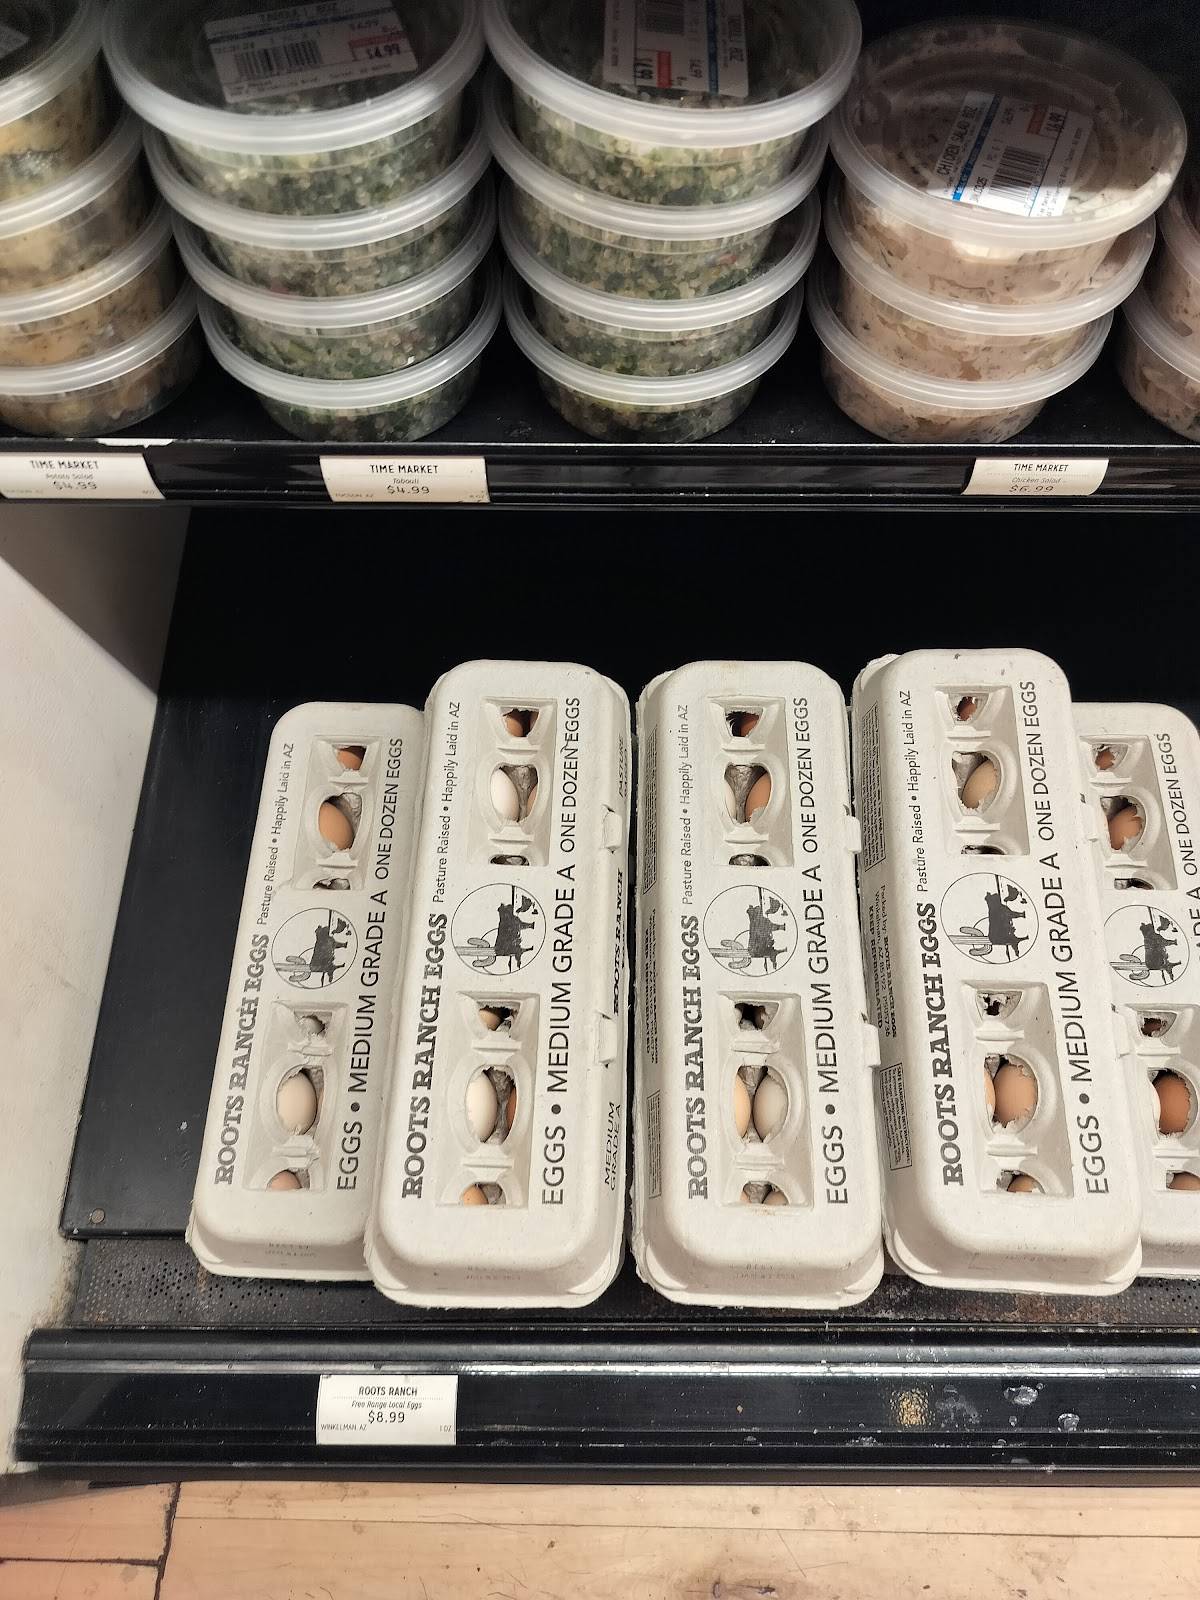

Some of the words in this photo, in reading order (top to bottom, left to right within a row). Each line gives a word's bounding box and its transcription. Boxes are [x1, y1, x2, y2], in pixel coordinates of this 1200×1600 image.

[937, 144, 961, 176] CHICKEN
[30, 460, 55, 469] TIME
[58, 460, 99, 469] MARKET
[369, 464, 394, 474] TIME
[398, 464, 440, 474] MARKET
[1013, 463, 1033, 472] TIME
[1035, 463, 1069, 473] MARKET
[386, 485, 430, 495] $4.99
[1009, 485, 1054, 493] $6.99
[449, 701, 460, 718] AZ
[565, 698, 580, 742] EGGS
[678, 704, 689, 720] AZ
[793, 697, 810, 742] EGGS
[900, 690, 911, 706] AZ
[904, 708, 913, 719] in
[1020, 681, 1039, 727] EGGS
[445, 733, 457, 756] Laid
[450, 720, 458, 731] in
[678, 735, 690, 759] Laid
[679, 722, 689, 733] in
[904, 720, 915, 745] Laid
[284, 743, 294, 759] AZ
[284, 760, 292, 769] in
[387, 738, 403, 779] EGGS
[907, 748, 921, 792] Happily
[1027, 733, 1049, 795] DOZEN
[1156, 733, 1177, 774] EGGS
[278, 771, 290, 793] Laid
[441, 758, 458, 802] Happily
[562, 747, 579, 807] DOZEN
[679, 761, 693, 805] Happily
[797, 748, 815, 808] DOZEN
[272, 796, 289, 835] Happily
[380, 784, 399, 839] DOZEN
[912, 805, 924, 845] Raised
[1034, 800, 1054, 841] ONE
[1166, 779, 1190, 834] DOZEN
[438, 815, 450, 854] Raised
[560, 813, 576, 853] ONE
[680, 817, 692, 859] Raised
[801, 813, 819, 853] ONE
[264, 847, 279, 882] Raised
[375, 843, 392, 880] ONE
[556, 864, 575, 881] A
[802, 864, 822, 882] A
[917, 847, 929, 893] Pasture
[1039, 853, 1060, 870] A
[1178, 838, 1198, 875] ONE
[370, 889, 388, 906] A
[433, 859, 447, 903] Pasture
[682, 860, 693, 905] Pasture
[257, 886, 273, 925] Pasture
[613, 870, 624, 942] RANCH
[1042, 877, 1073, 962] GRADE
[361, 911, 386, 987] GRADE
[423, 913, 448, 980] EGGS
[552, 888, 575, 973] GRADE
[681, 915, 701, 980] EGGS
[803, 889, 830, 974] GRADE
[917, 902, 942, 970] EGGS
[243, 934, 269, 992] EGGS
[612, 944, 623, 1016] ROOTS
[229, 997, 259, 1091] RANCH
[348, 995, 377, 1093] MEDIUM
[412, 985, 441, 1091] RANCH
[547, 982, 571, 1093] MEDIUM
[683, 986, 705, 1091] RANCH
[812, 983, 839, 1093] MEDIUM
[923, 974, 953, 1078] RANCH
[1055, 972, 1093, 1082] MEDIUM
[214, 1095, 244, 1185] ROOTS
[337, 1120, 363, 1190] EGGS
[402, 1096, 430, 1199] ROOTS
[604, 1102, 615, 1185] MEDIUM
[610, 1115, 620, 1192] GRADE
[687, 1097, 708, 1199] ROOTS
[935, 1084, 963, 1186] ROOTS
[1077, 1114, 1109, 1195] EGGS
[542, 1124, 566, 1205] EGGS
[822, 1124, 848, 1205] EGGS
[352, 1400, 365, 1408] Free
[367, 1401, 387, 1409] Range
[388, 1400, 405, 1408] Local
[407, 1401, 422, 1410] Eggs
[359, 1386, 386, 1396] ROOTS
[389, 1386, 418, 1396] RANCH
[368, 1410, 405, 1424] $8.99
